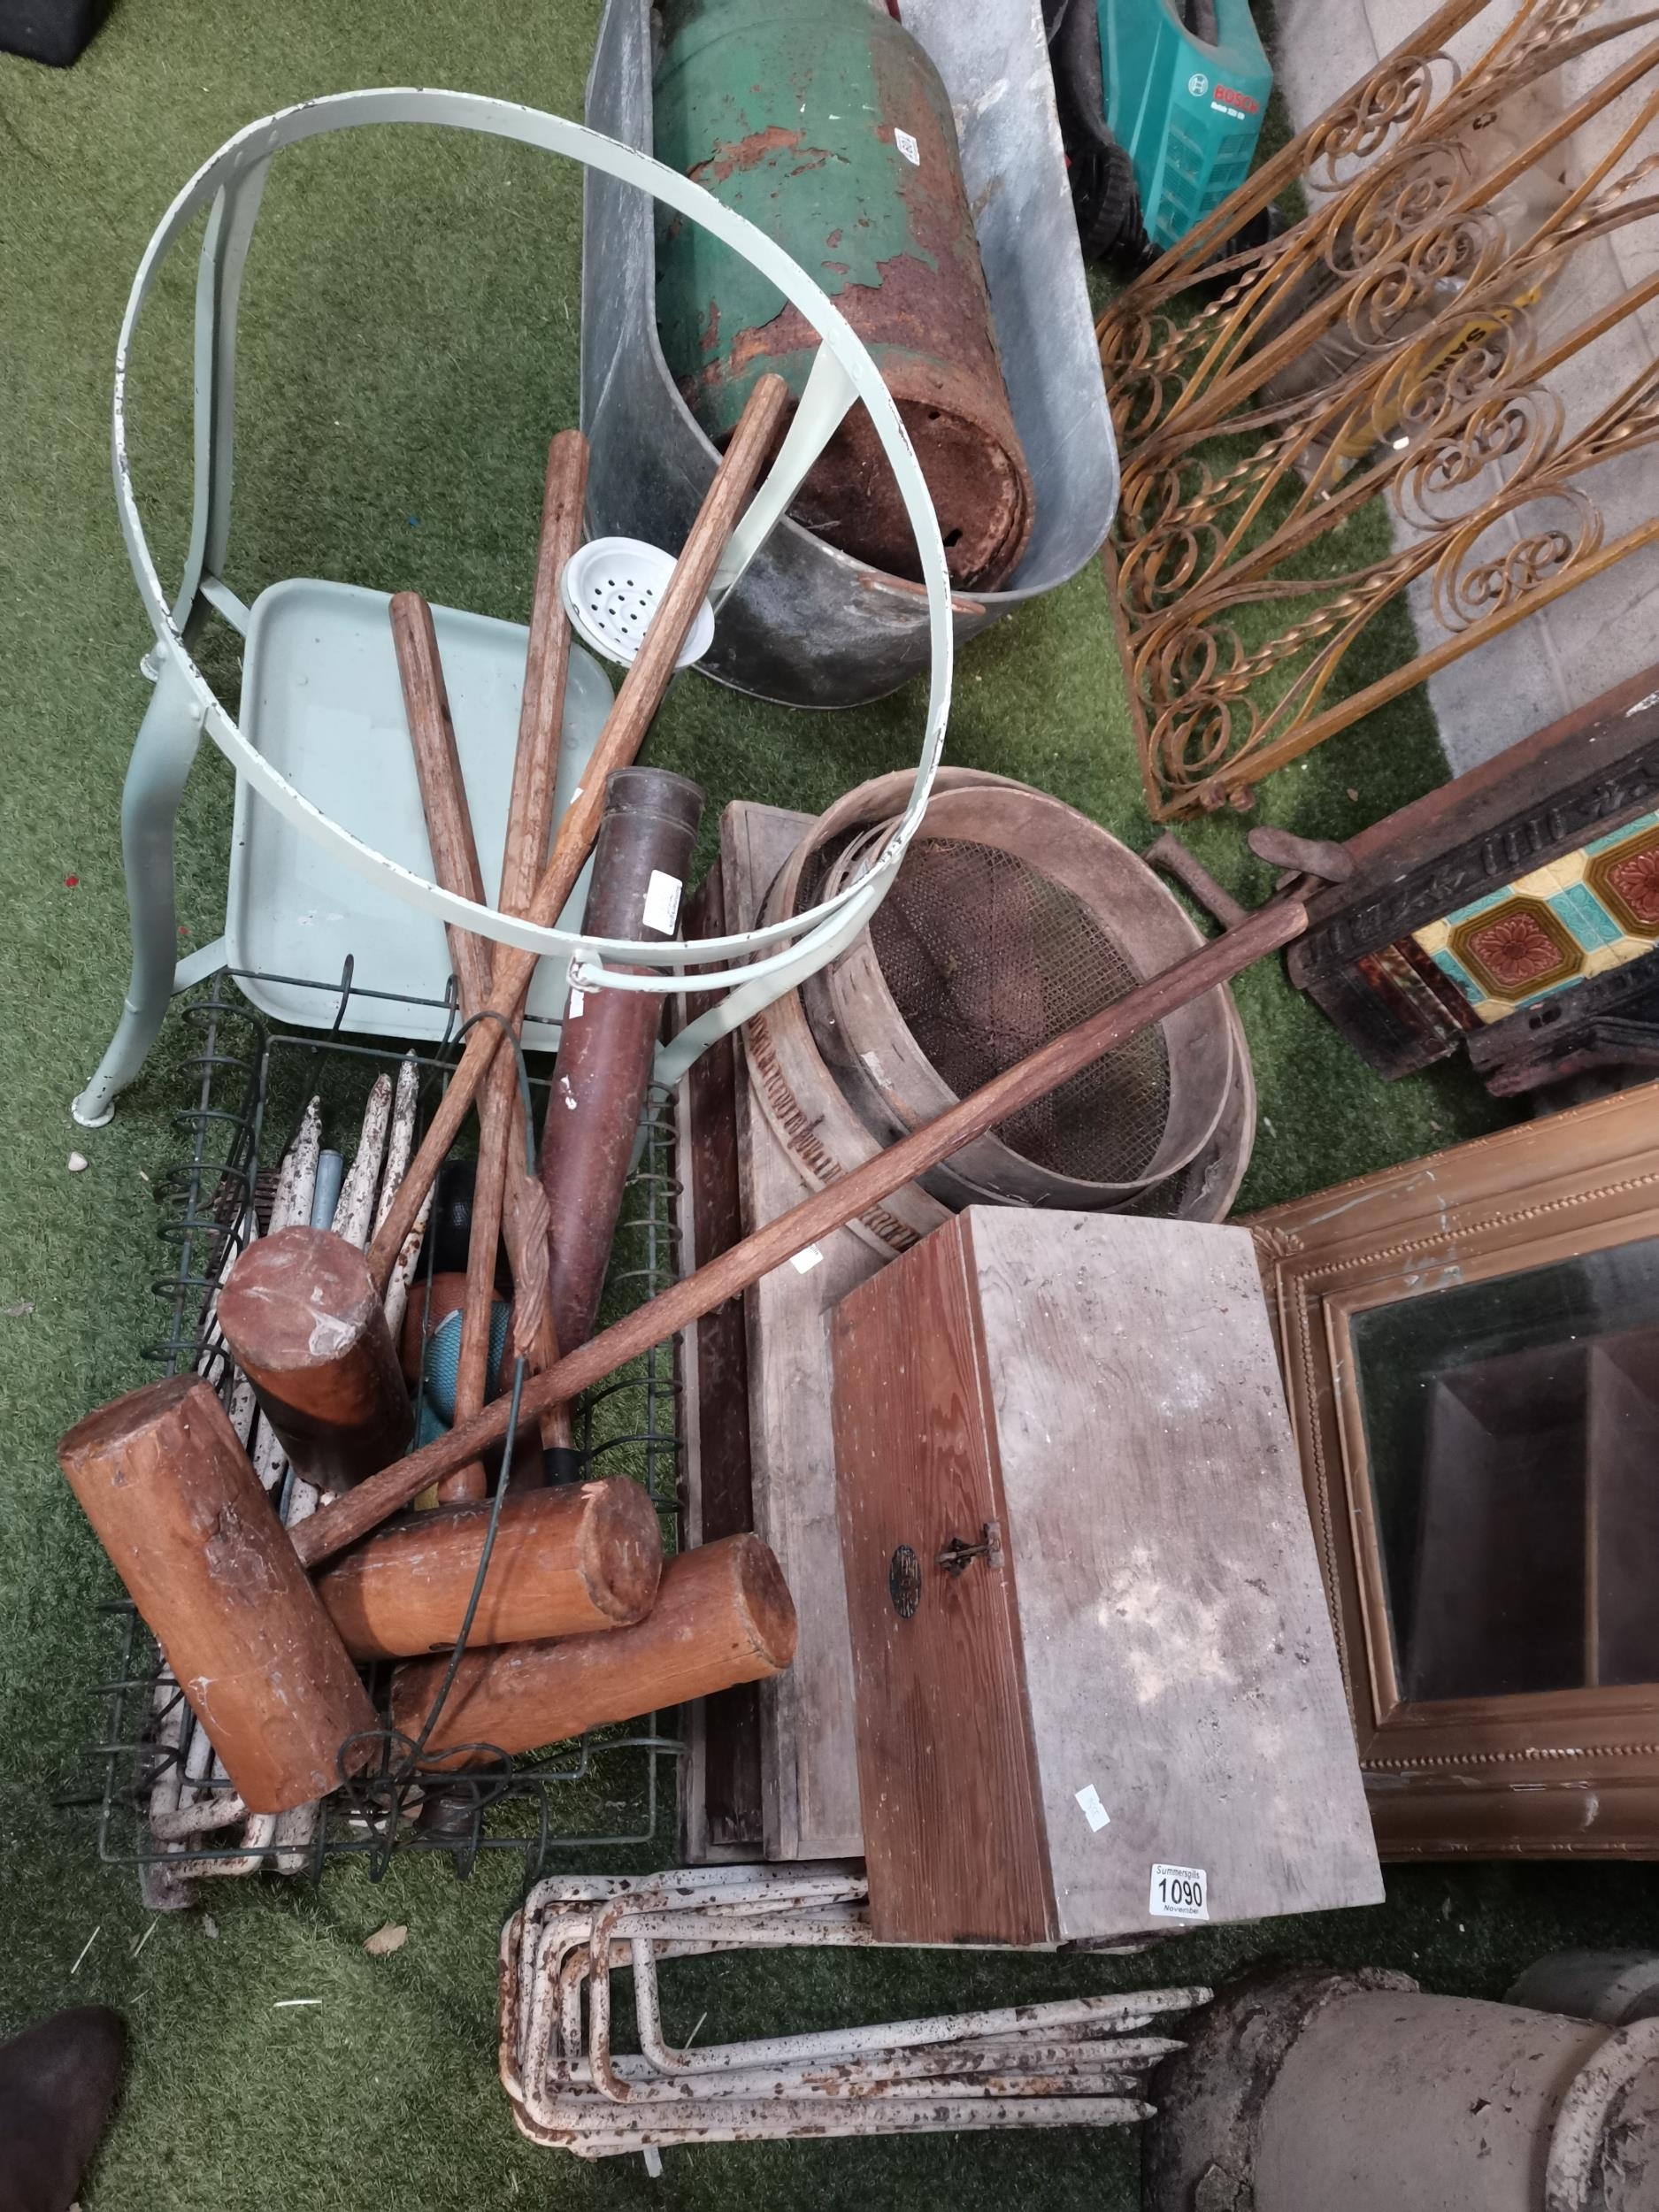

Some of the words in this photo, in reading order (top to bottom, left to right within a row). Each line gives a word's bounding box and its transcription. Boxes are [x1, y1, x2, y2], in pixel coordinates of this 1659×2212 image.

[1214, 84, 1258, 113] BOSCH
[1159, 1878, 1202, 1907] 1090
[1164, 1904, 1199, 1914] November
